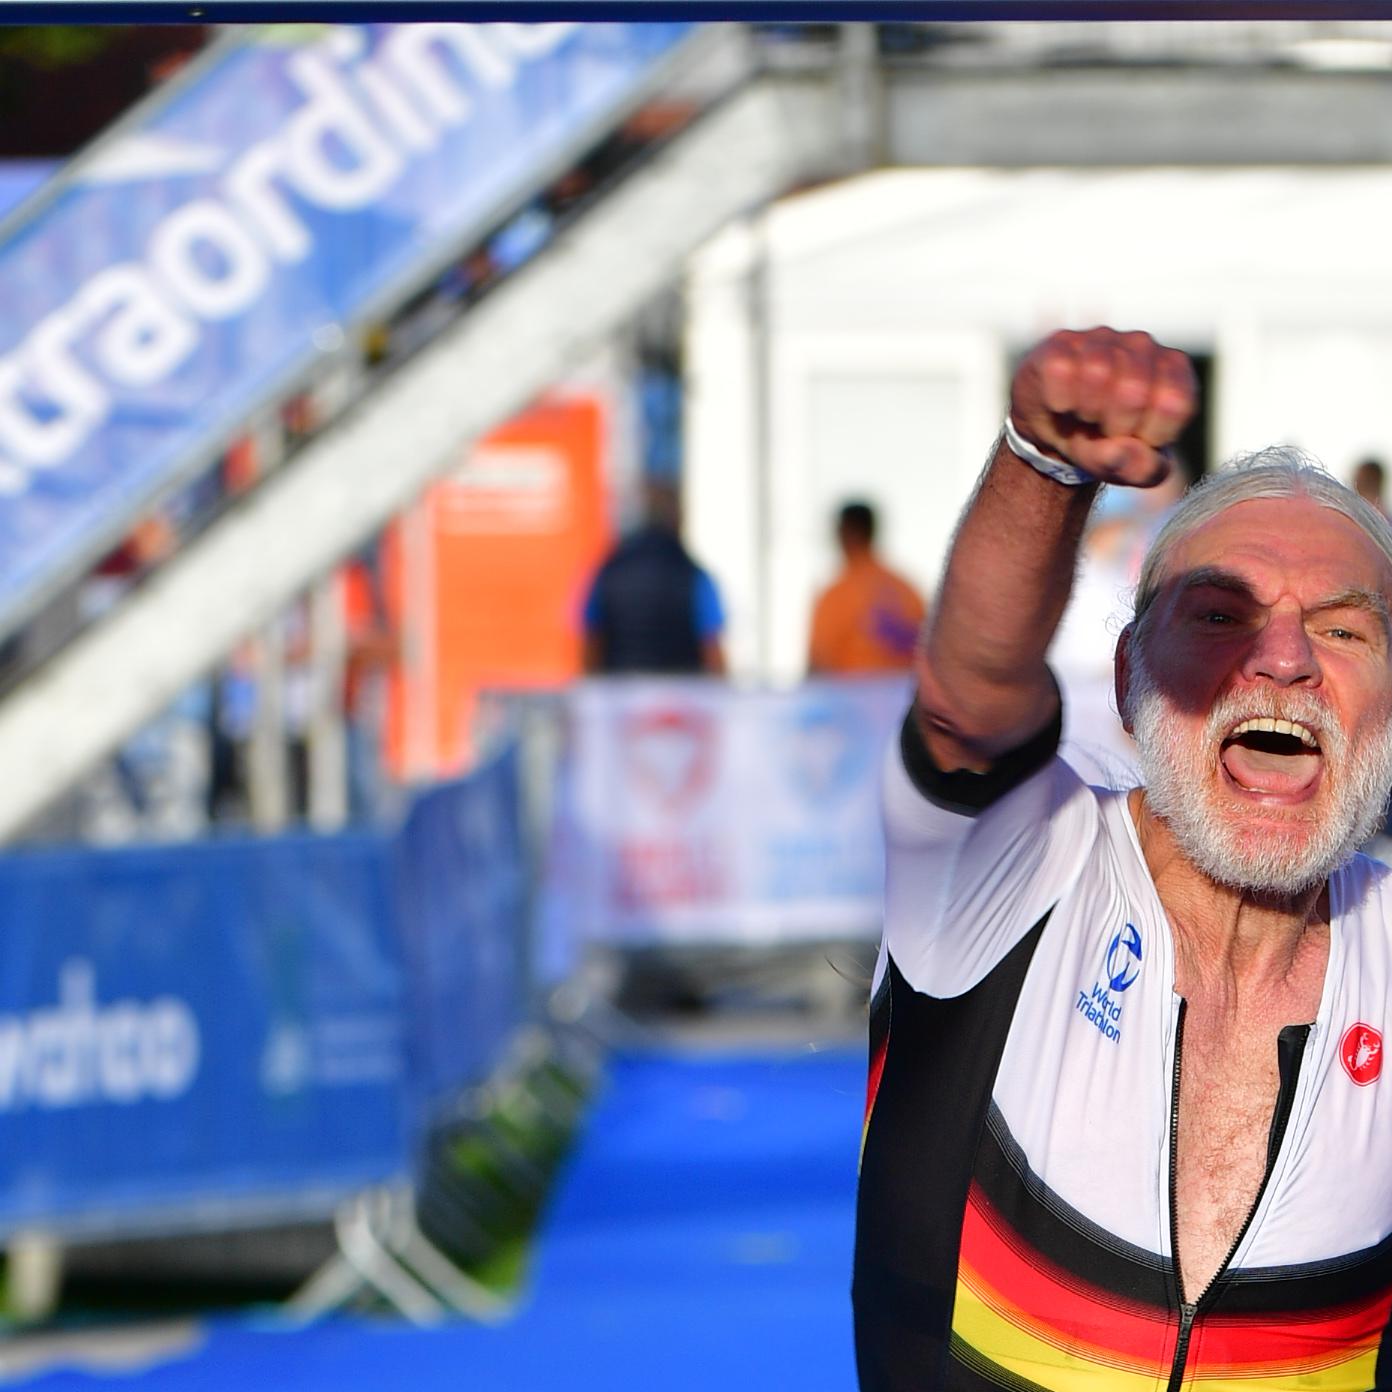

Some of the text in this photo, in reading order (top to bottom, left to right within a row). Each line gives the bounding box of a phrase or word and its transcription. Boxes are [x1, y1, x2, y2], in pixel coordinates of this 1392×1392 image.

[0, 20, 585, 495] traordin
[1076, 990, 1121, 1044] Triathlon
[1091, 981, 1122, 1021] World
